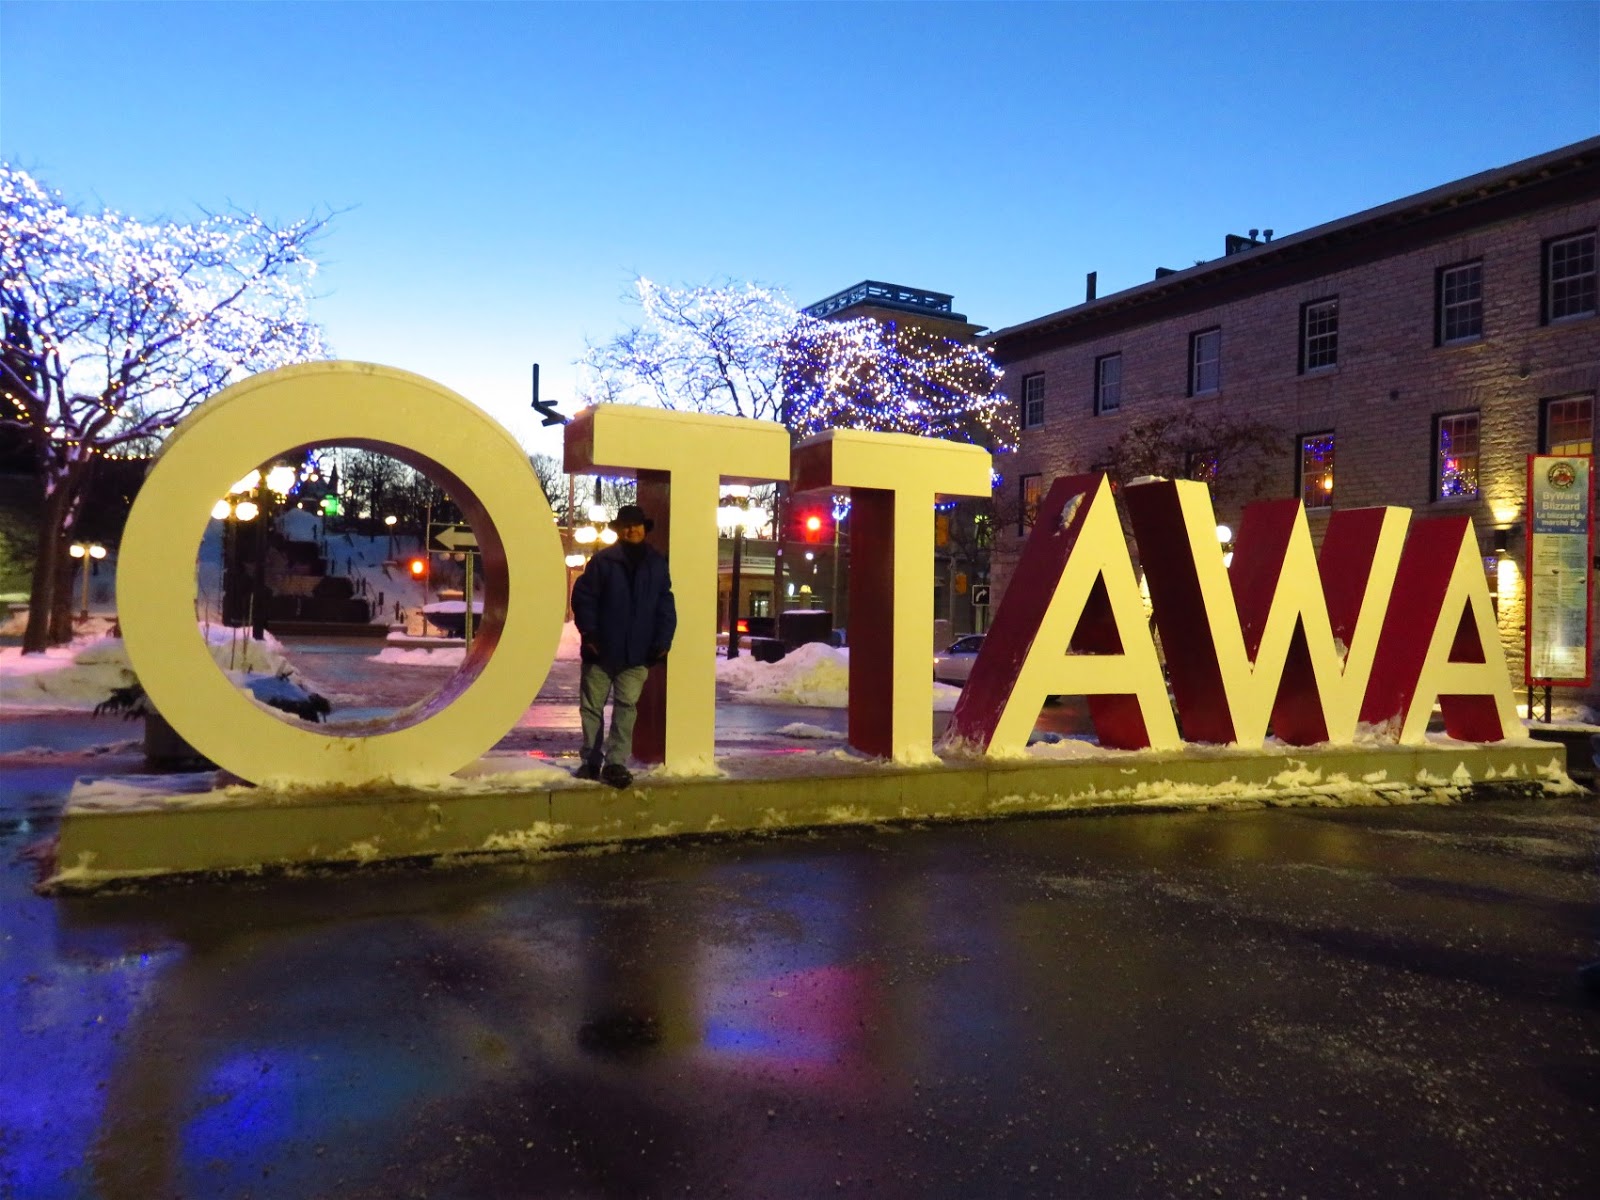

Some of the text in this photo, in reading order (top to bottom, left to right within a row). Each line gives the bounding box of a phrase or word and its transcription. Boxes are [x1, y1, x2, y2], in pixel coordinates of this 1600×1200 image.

[1542, 492, 1580, 501] ByWard
[1542, 502, 1580, 510] Blizzard
[1570, 519, 1580, 527] By
[117, 361, 1530, 791] OTTAWA
